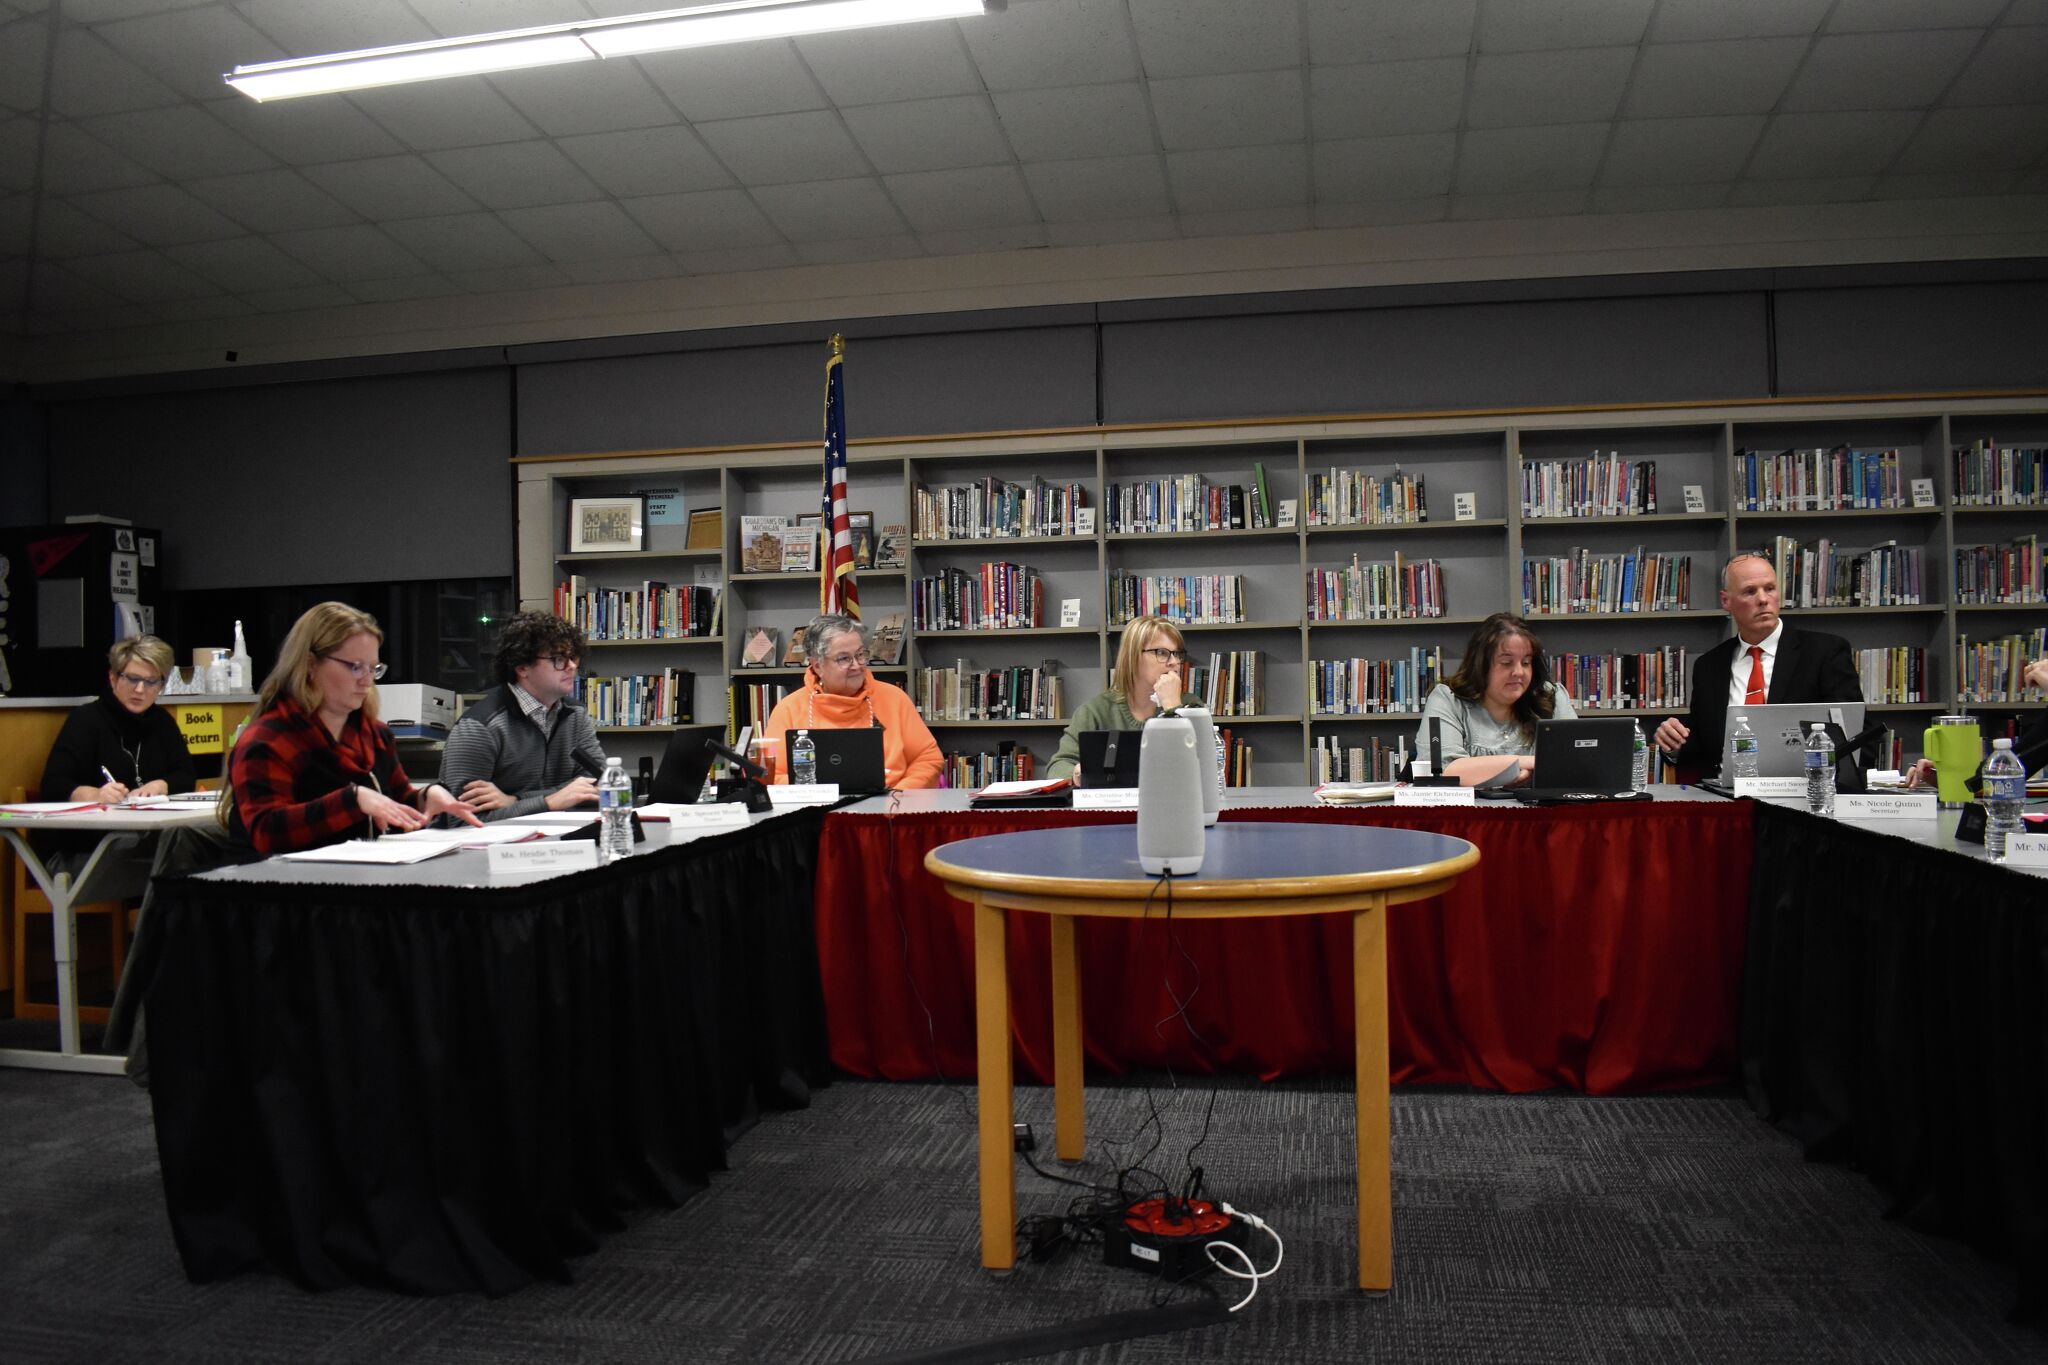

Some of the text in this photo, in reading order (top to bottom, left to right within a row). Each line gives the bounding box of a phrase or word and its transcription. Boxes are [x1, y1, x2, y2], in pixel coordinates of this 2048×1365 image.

[120, 560, 129, 569] NO
[116, 569, 132, 577] LIMIT
[185, 711, 214, 725] Book
[1894, 800, 1922, 808] Quinn
[2015, 842, 2033, 852] Mr.
[500, 851, 515, 860] Ms.
[549, 848, 585, 857] Thomas
